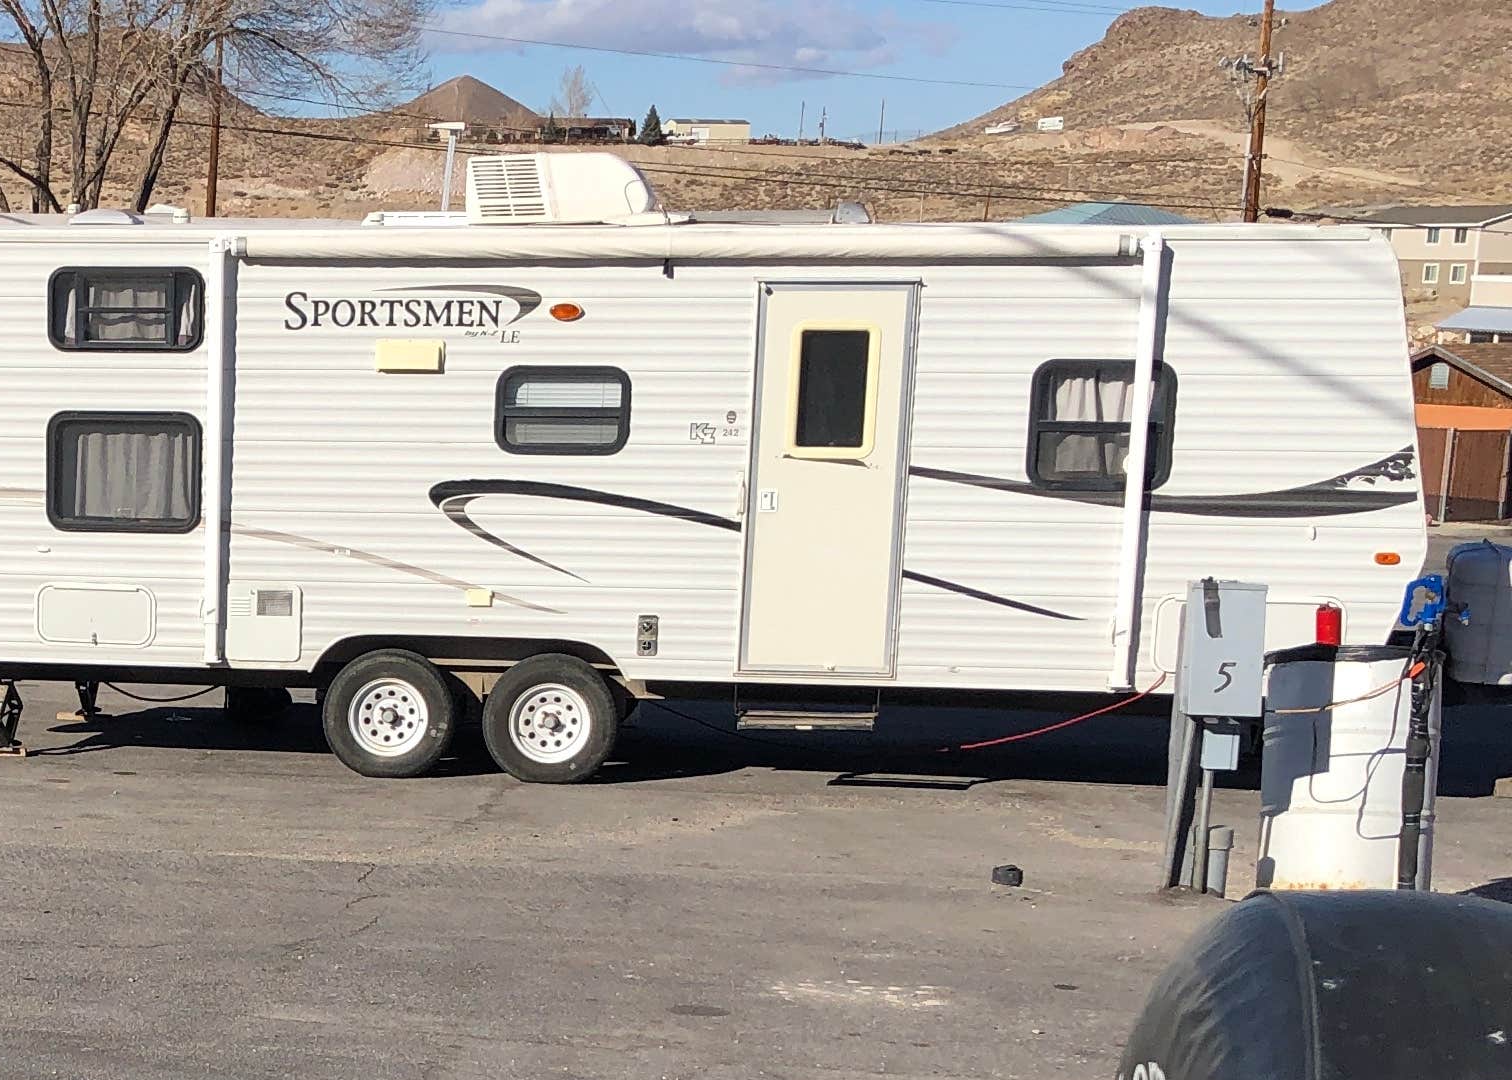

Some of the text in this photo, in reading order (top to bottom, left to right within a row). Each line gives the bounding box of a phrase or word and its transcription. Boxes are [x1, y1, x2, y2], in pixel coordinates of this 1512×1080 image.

[284, 291, 503, 331] SPORTSMEN
[500, 330, 521, 344] LE
[1213, 662, 1237, 694] 5
